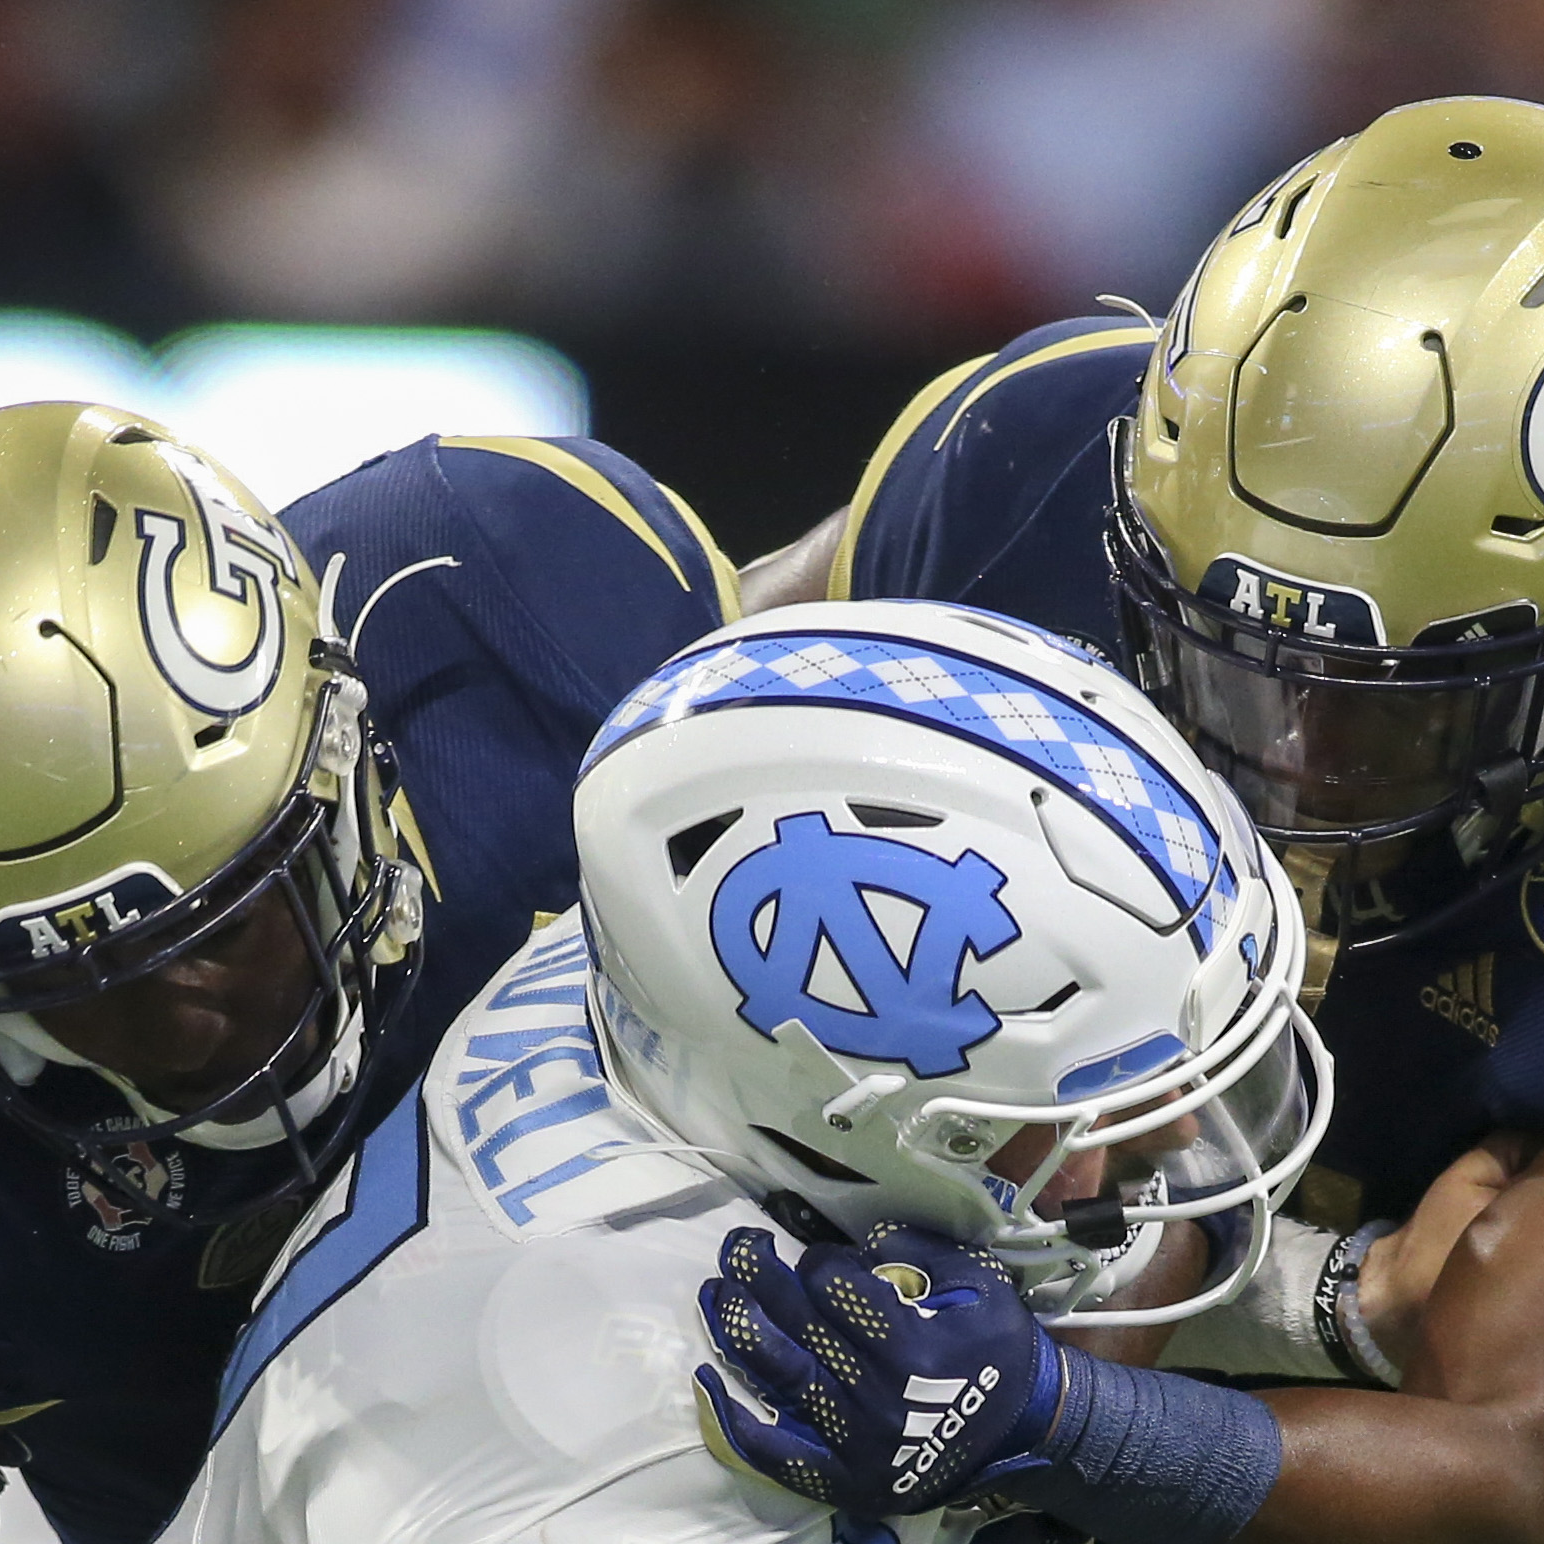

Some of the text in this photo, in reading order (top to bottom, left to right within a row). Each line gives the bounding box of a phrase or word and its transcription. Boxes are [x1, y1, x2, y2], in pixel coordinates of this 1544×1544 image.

[1228, 566, 1339, 637] ATL
[21, 891, 143, 959] ATL
[1419, 985, 1500, 1048] adidas
[1314, 1275, 1340, 1315] AM
[891, 1363, 1002, 1496] adidas
